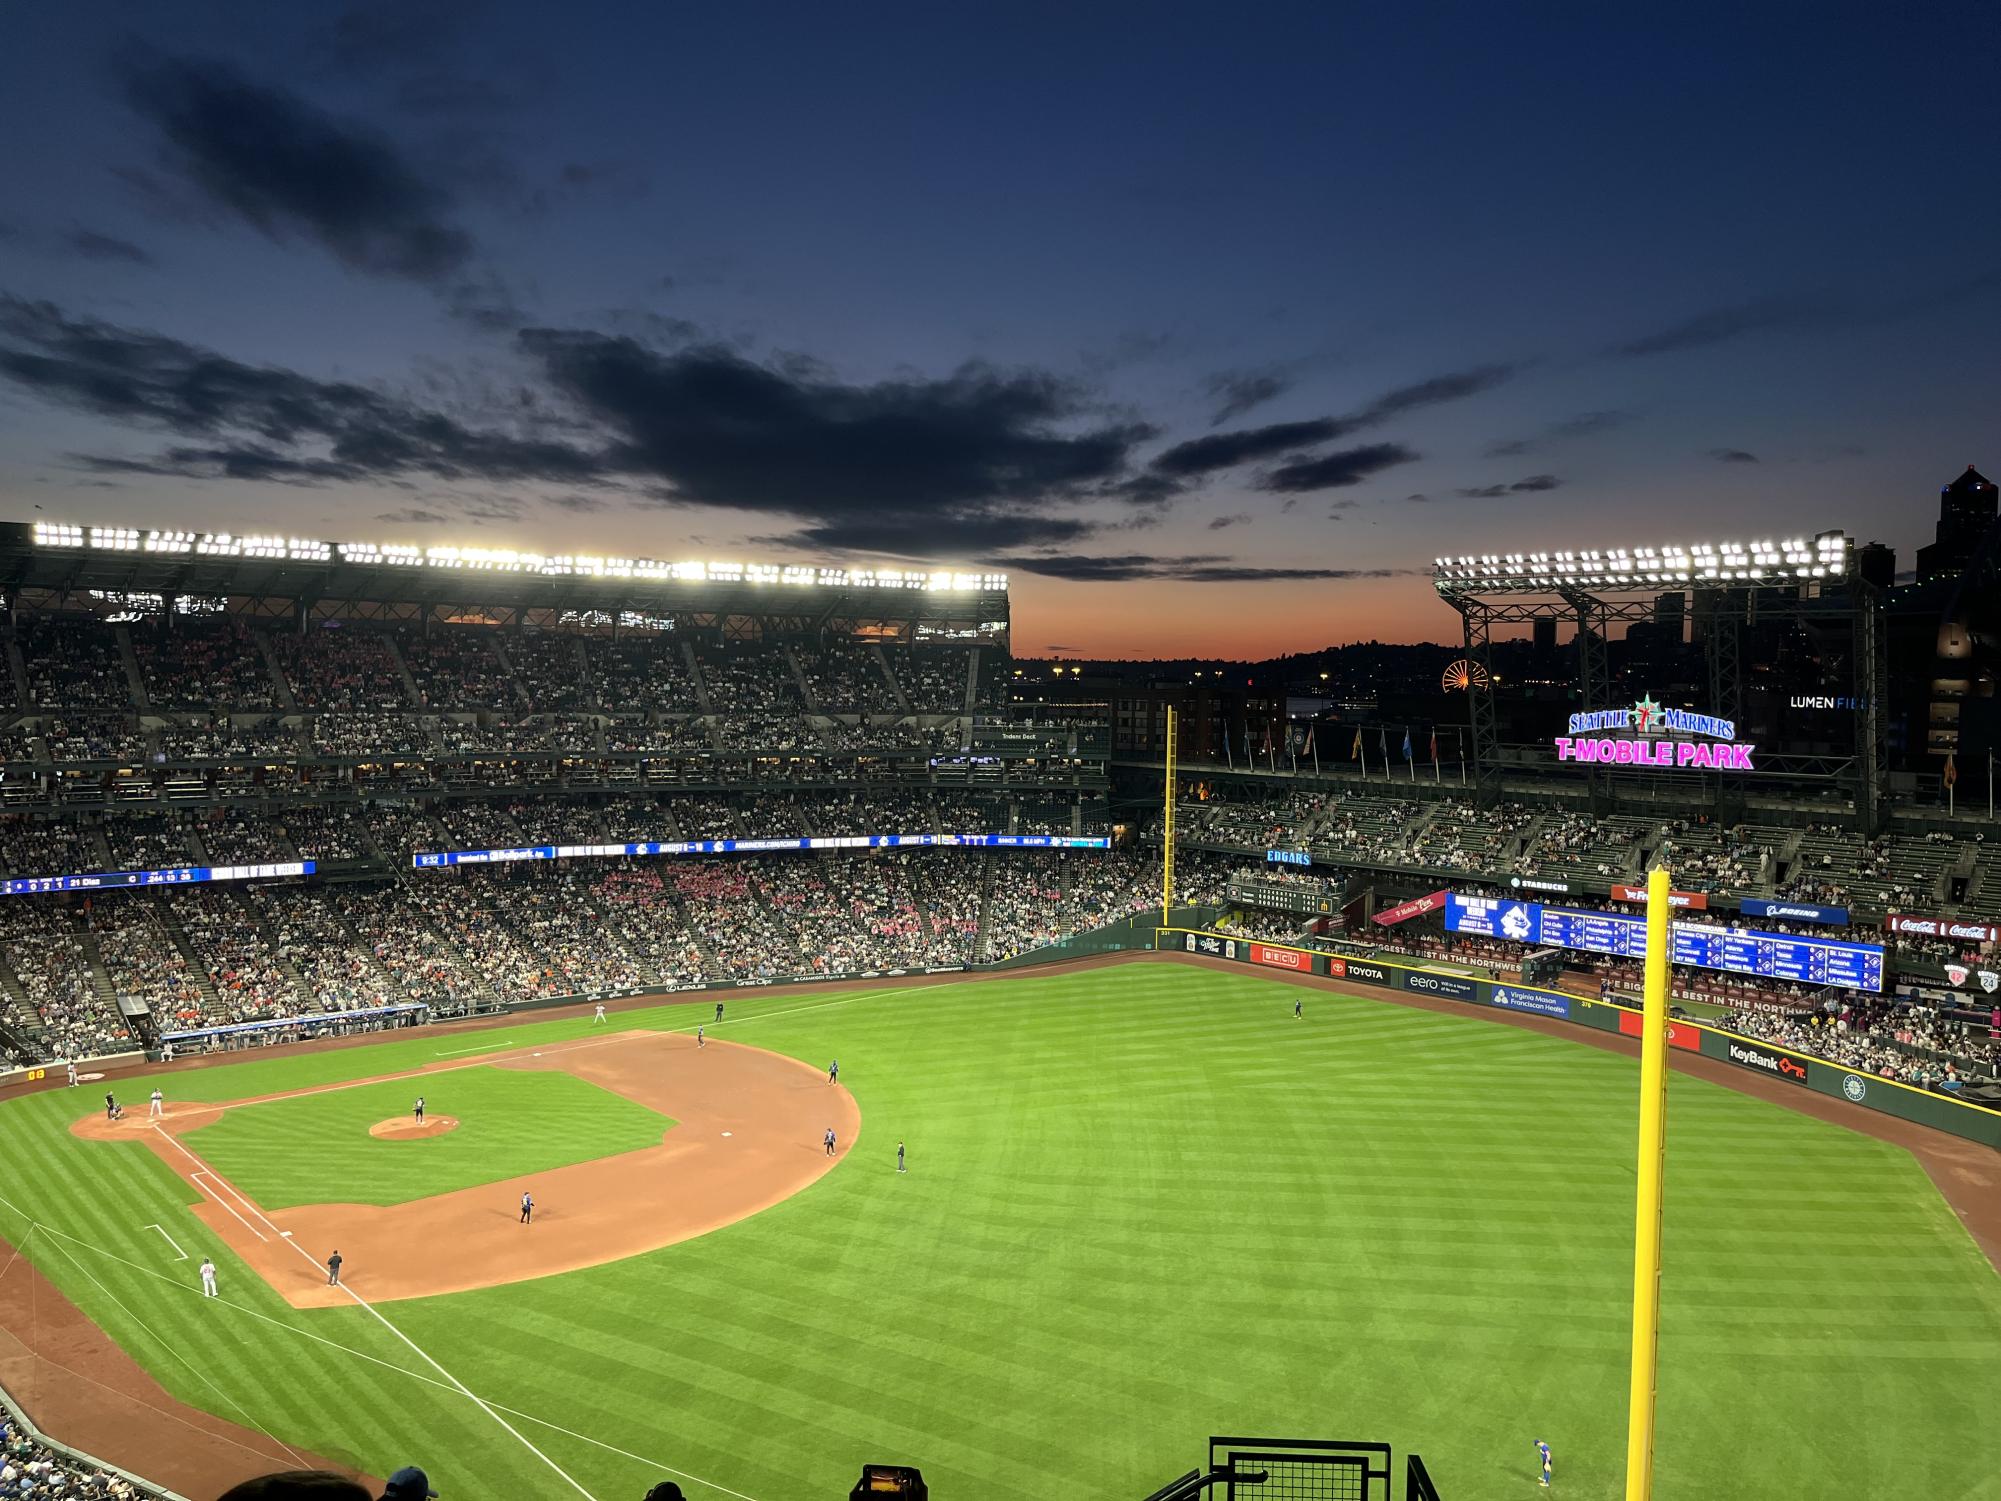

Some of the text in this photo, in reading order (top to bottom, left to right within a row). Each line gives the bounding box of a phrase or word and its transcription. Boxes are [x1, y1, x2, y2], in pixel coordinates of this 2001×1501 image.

[1791, 697, 1834, 708] LUMEN
[1569, 710, 1630, 734] SEATTLE
[1664, 708, 1735, 740] MARINERS
[1555, 738, 1755, 770] T-MOBILE PARK
[660, 843, 682, 852] AUGUST
[1522, 880, 1568, 892] STARBUCKS
[1900, 920, 1936, 934] Coca-Cola
[1949, 925, 1986, 939] Coca-Cola
[1265, 951, 1296, 964] BECU
[1451, 955, 1467, 963] THE
[1470, 958, 1522, 972] NORTHWES
[1348, 966, 1383, 980] TOYOTA
[756, 978, 773, 986] Clips
[1410, 977, 1438, 989] eero
[1984, 979, 1993, 988] 24
[1511, 992, 1534, 1001] Virginia
[1683, 991, 1710, 1002] BEST
[1713, 996, 1725, 1005] IN
[1728, 998, 1750, 1009] THE
[1511, 999, 1565, 1013] Franciscan Health
[1730, 1045, 1778, 1070] KeyBank
